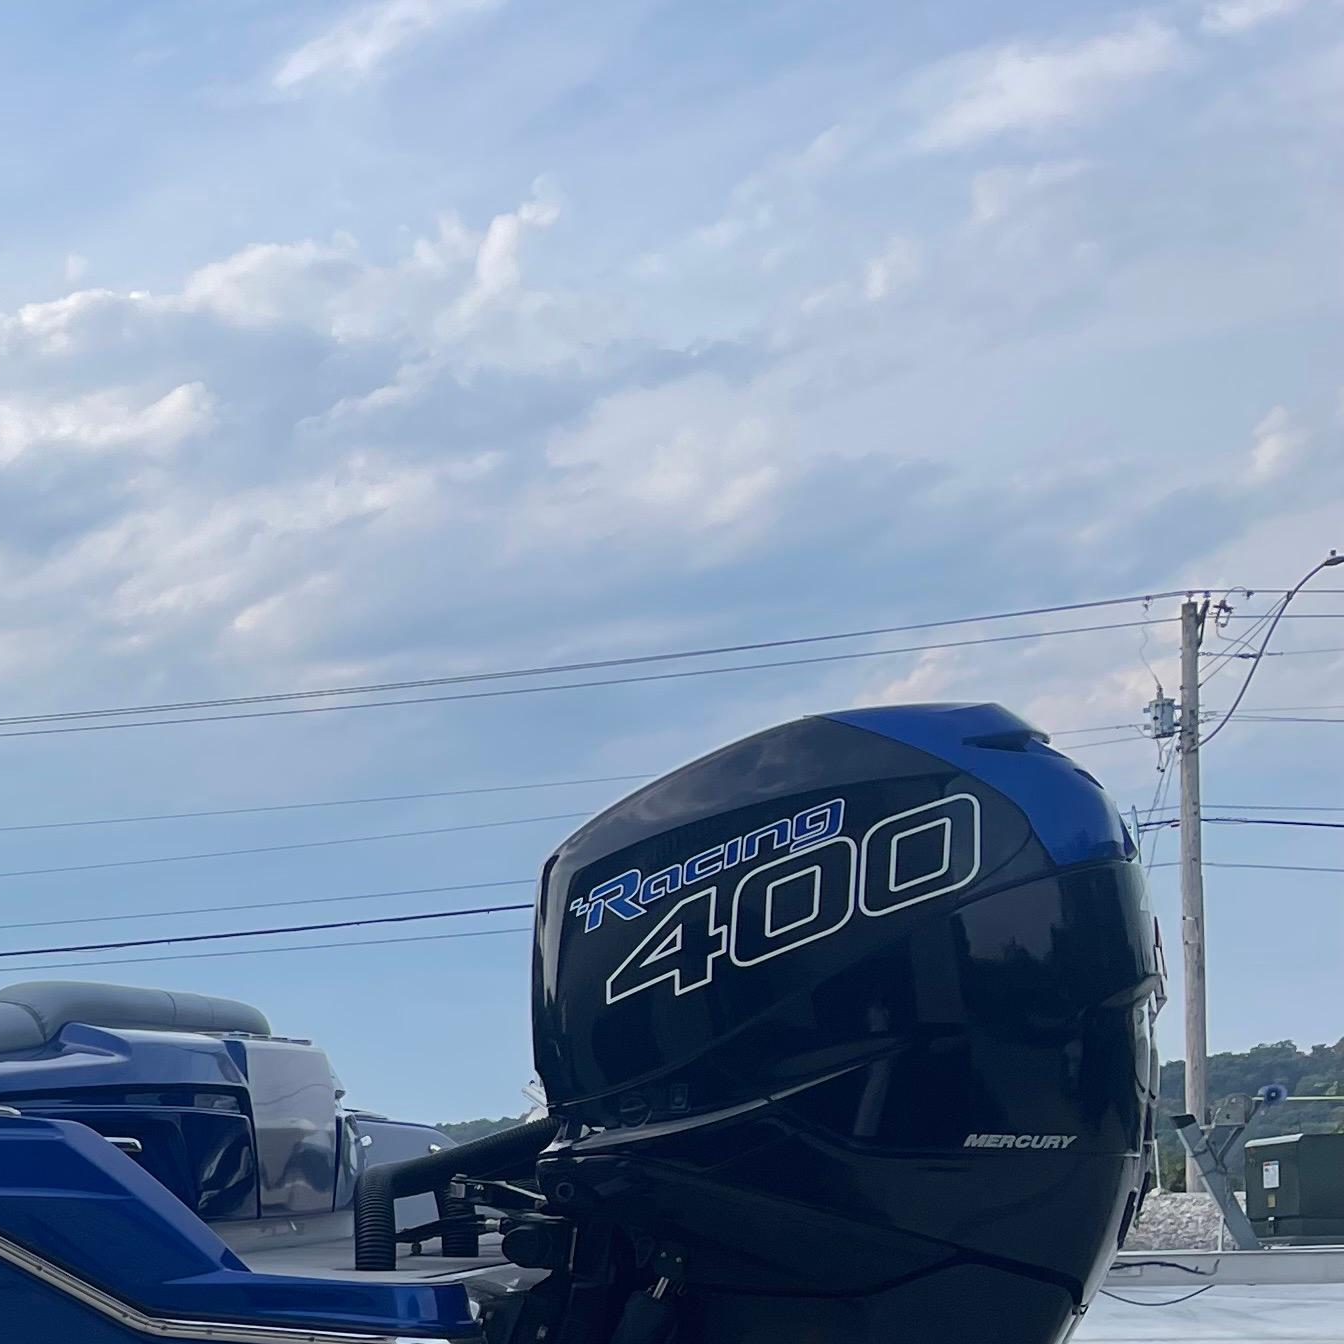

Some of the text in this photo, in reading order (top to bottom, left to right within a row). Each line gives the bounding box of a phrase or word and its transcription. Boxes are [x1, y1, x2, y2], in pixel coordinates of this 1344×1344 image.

[570, 798, 846, 934] Racing
[605, 792, 982, 1005] 400
[963, 1133, 1078, 1149] MERCURY
